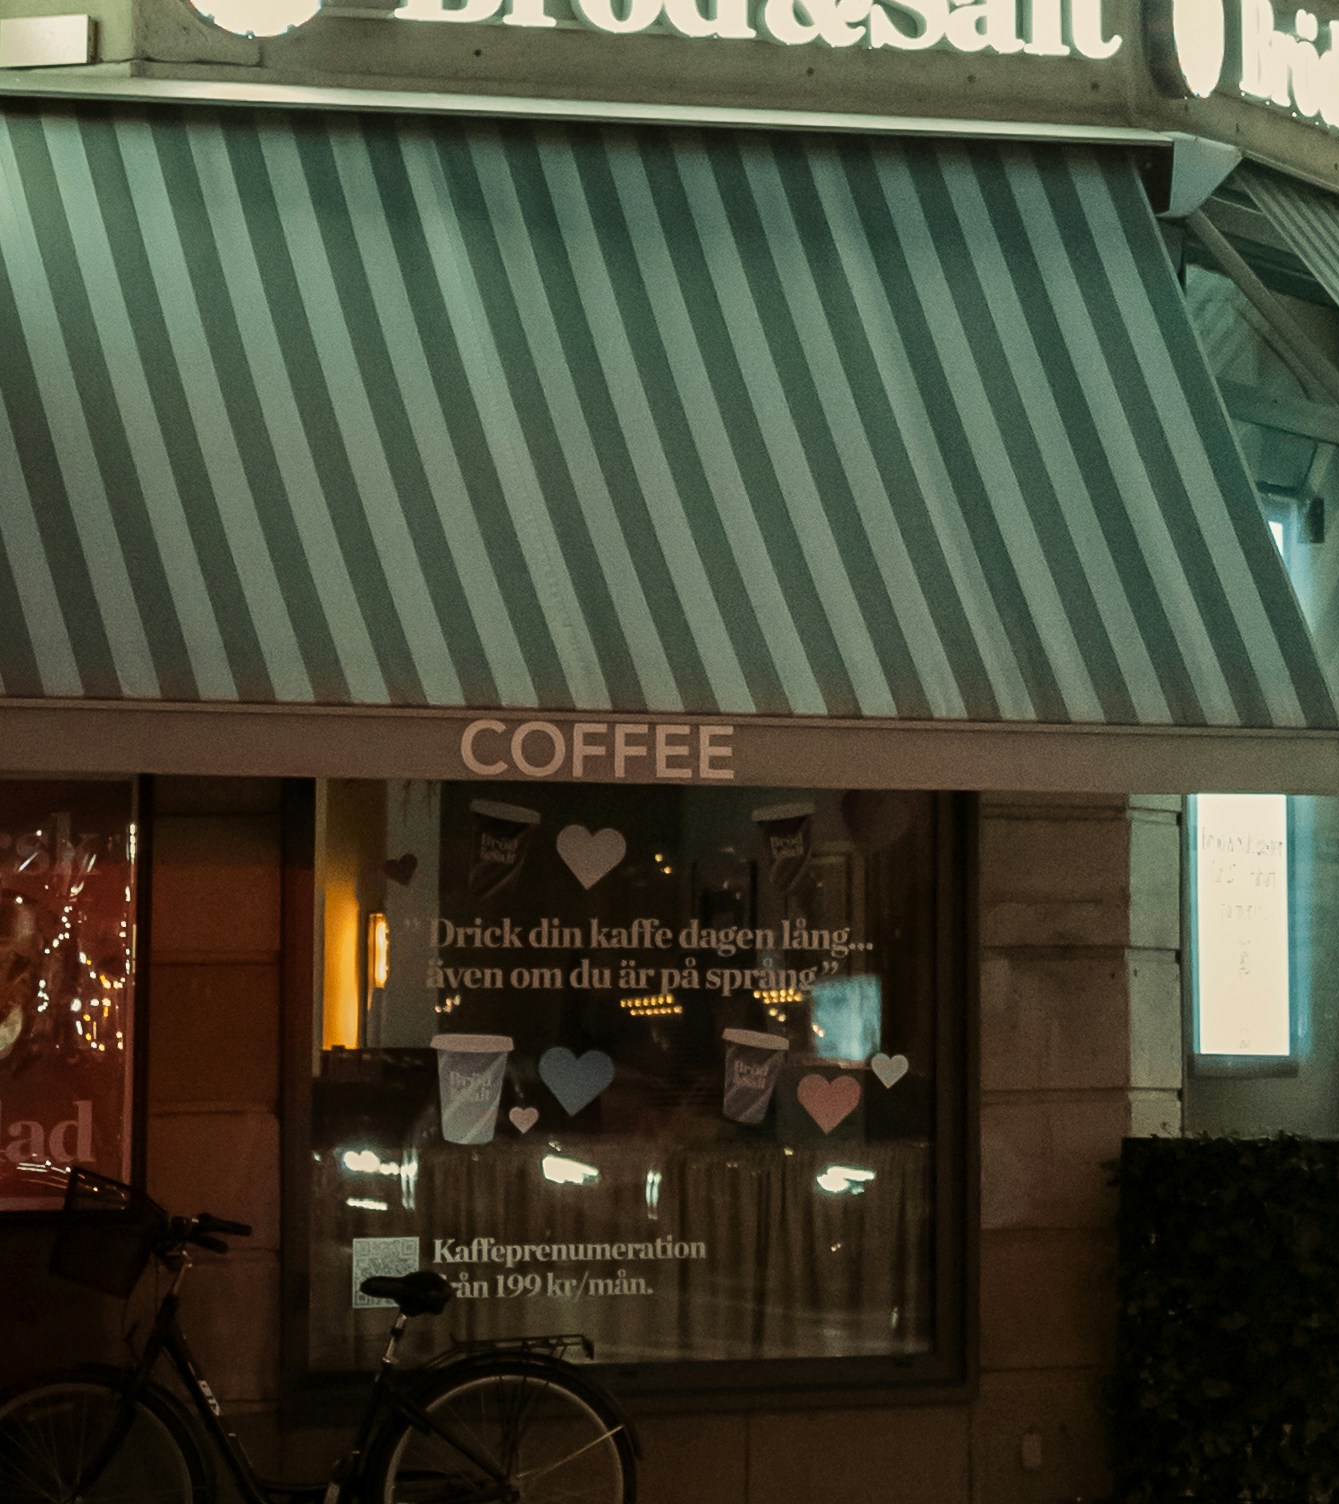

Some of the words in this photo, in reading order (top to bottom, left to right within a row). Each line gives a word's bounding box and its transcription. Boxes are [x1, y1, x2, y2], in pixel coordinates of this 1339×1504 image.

[460, 719, 736, 780] COFFEE
[528, 918, 583, 949] din
[589, 918, 674, 950] kaffe
[679, 918, 776, 957] dagen
[426, 959, 503, 990] även
[510, 967, 565, 990] om
[569, 959, 613, 990] du
[620, 959, 651, 990] är
[660, 957, 701, 1000] på
[432, 1234, 707, 1268] Kaffeprenumeration
[496, 1272, 542, 1298] 199
